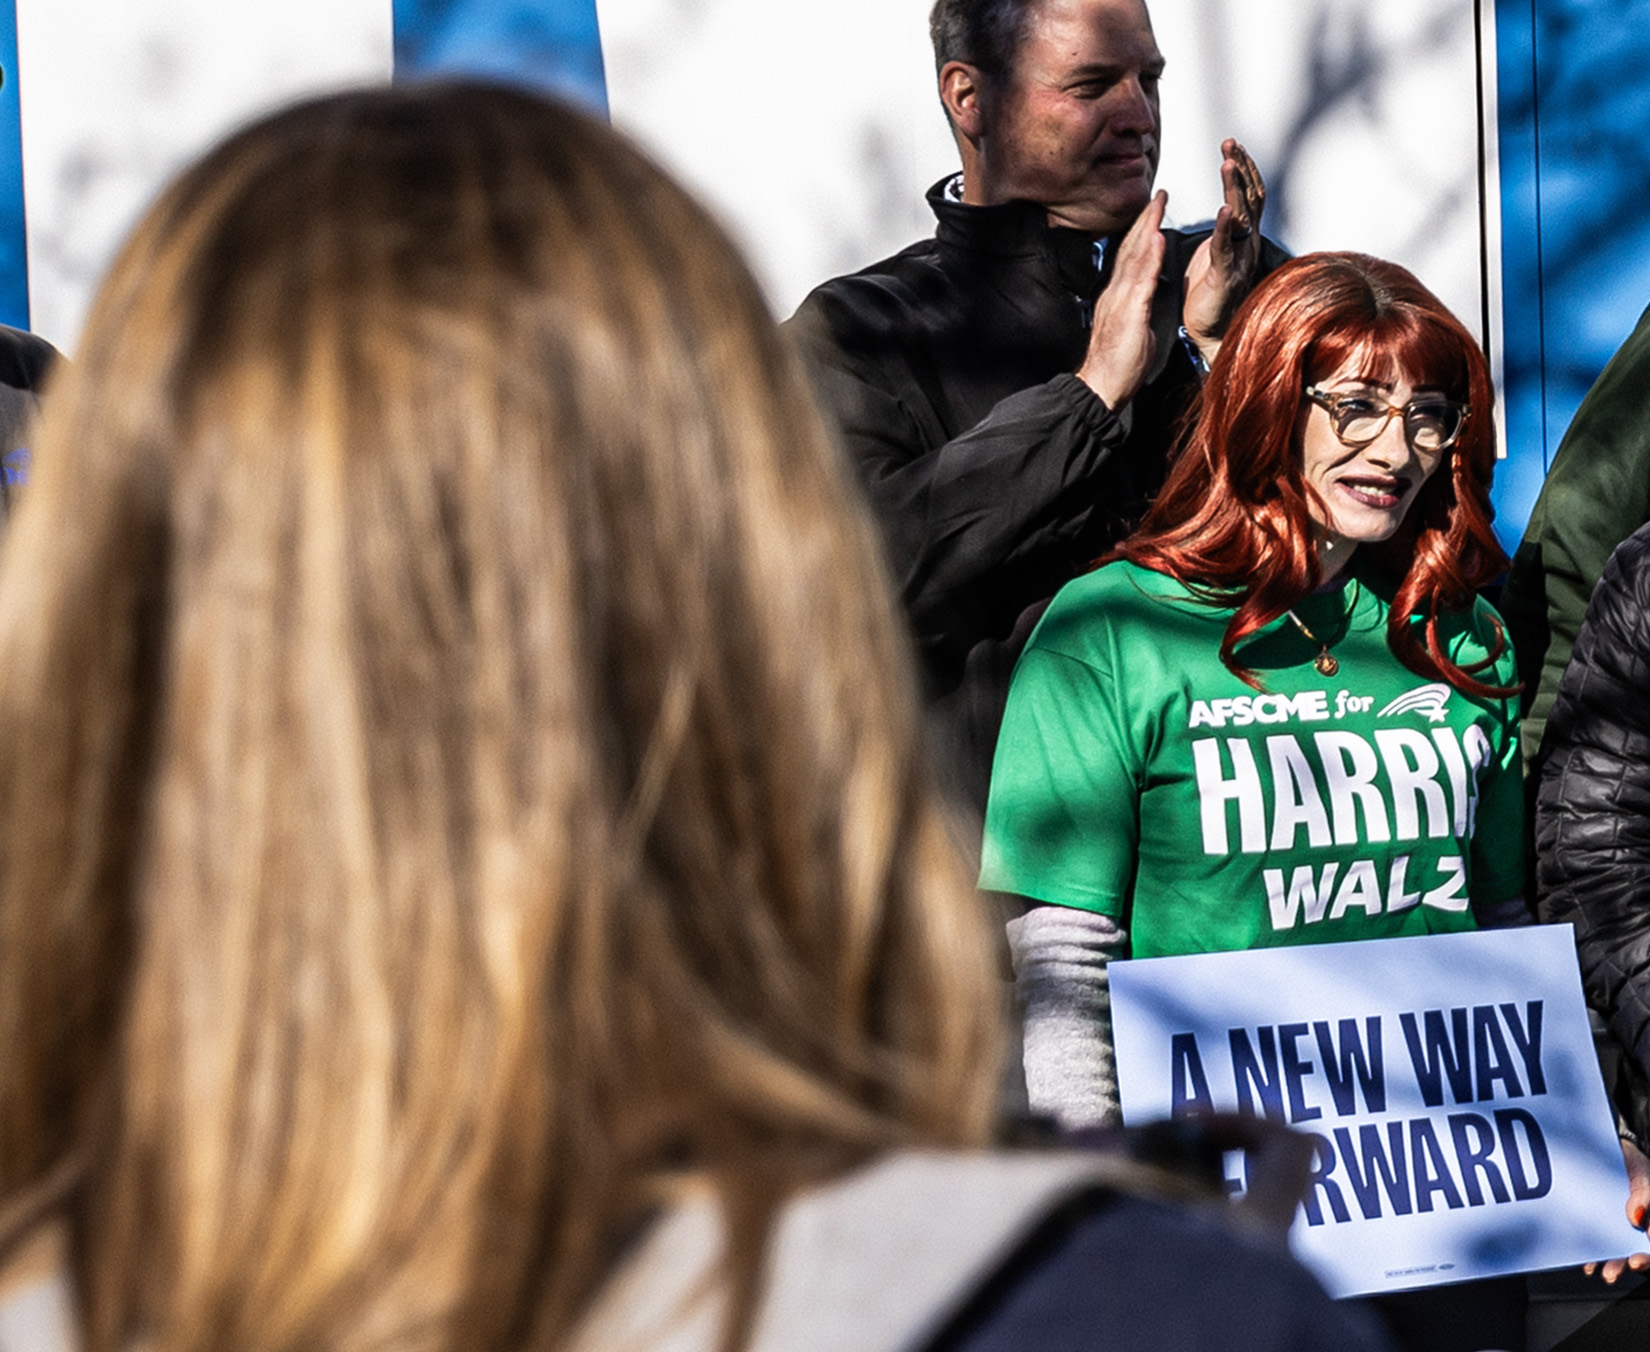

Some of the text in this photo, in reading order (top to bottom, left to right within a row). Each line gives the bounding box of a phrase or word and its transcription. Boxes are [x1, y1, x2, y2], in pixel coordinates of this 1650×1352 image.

[1188, 689, 1376, 729] AFSCME for
[1262, 855, 1470, 931] WALZ
[1170, 999, 1548, 1125] A NEW WAY
